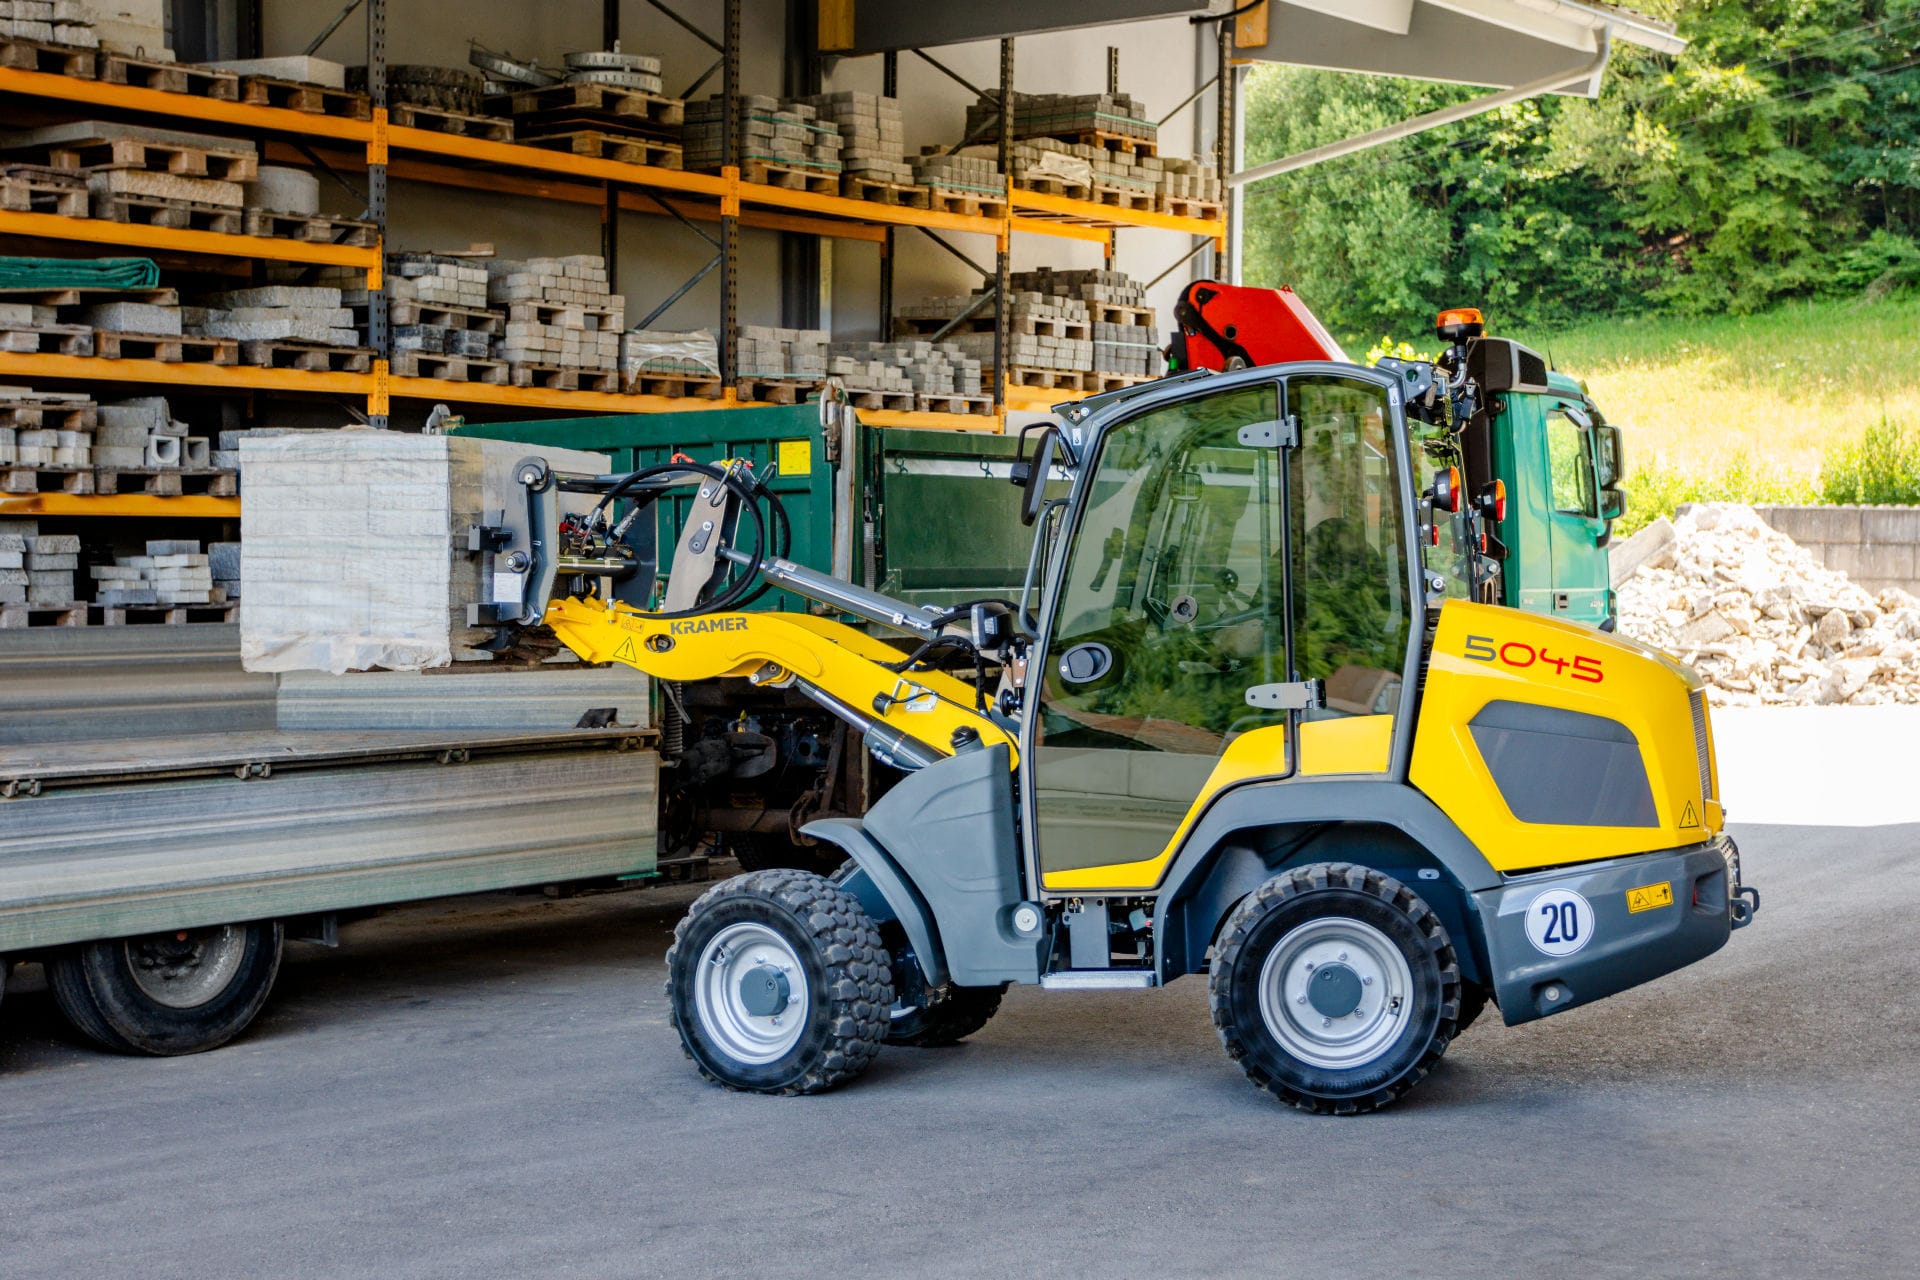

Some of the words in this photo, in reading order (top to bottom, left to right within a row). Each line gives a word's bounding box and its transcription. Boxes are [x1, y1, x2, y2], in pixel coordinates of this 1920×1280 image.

[670, 617, 749, 635] KRAMER
[1464, 634, 1604, 683] 5045
[1541, 901, 1578, 944] 20
